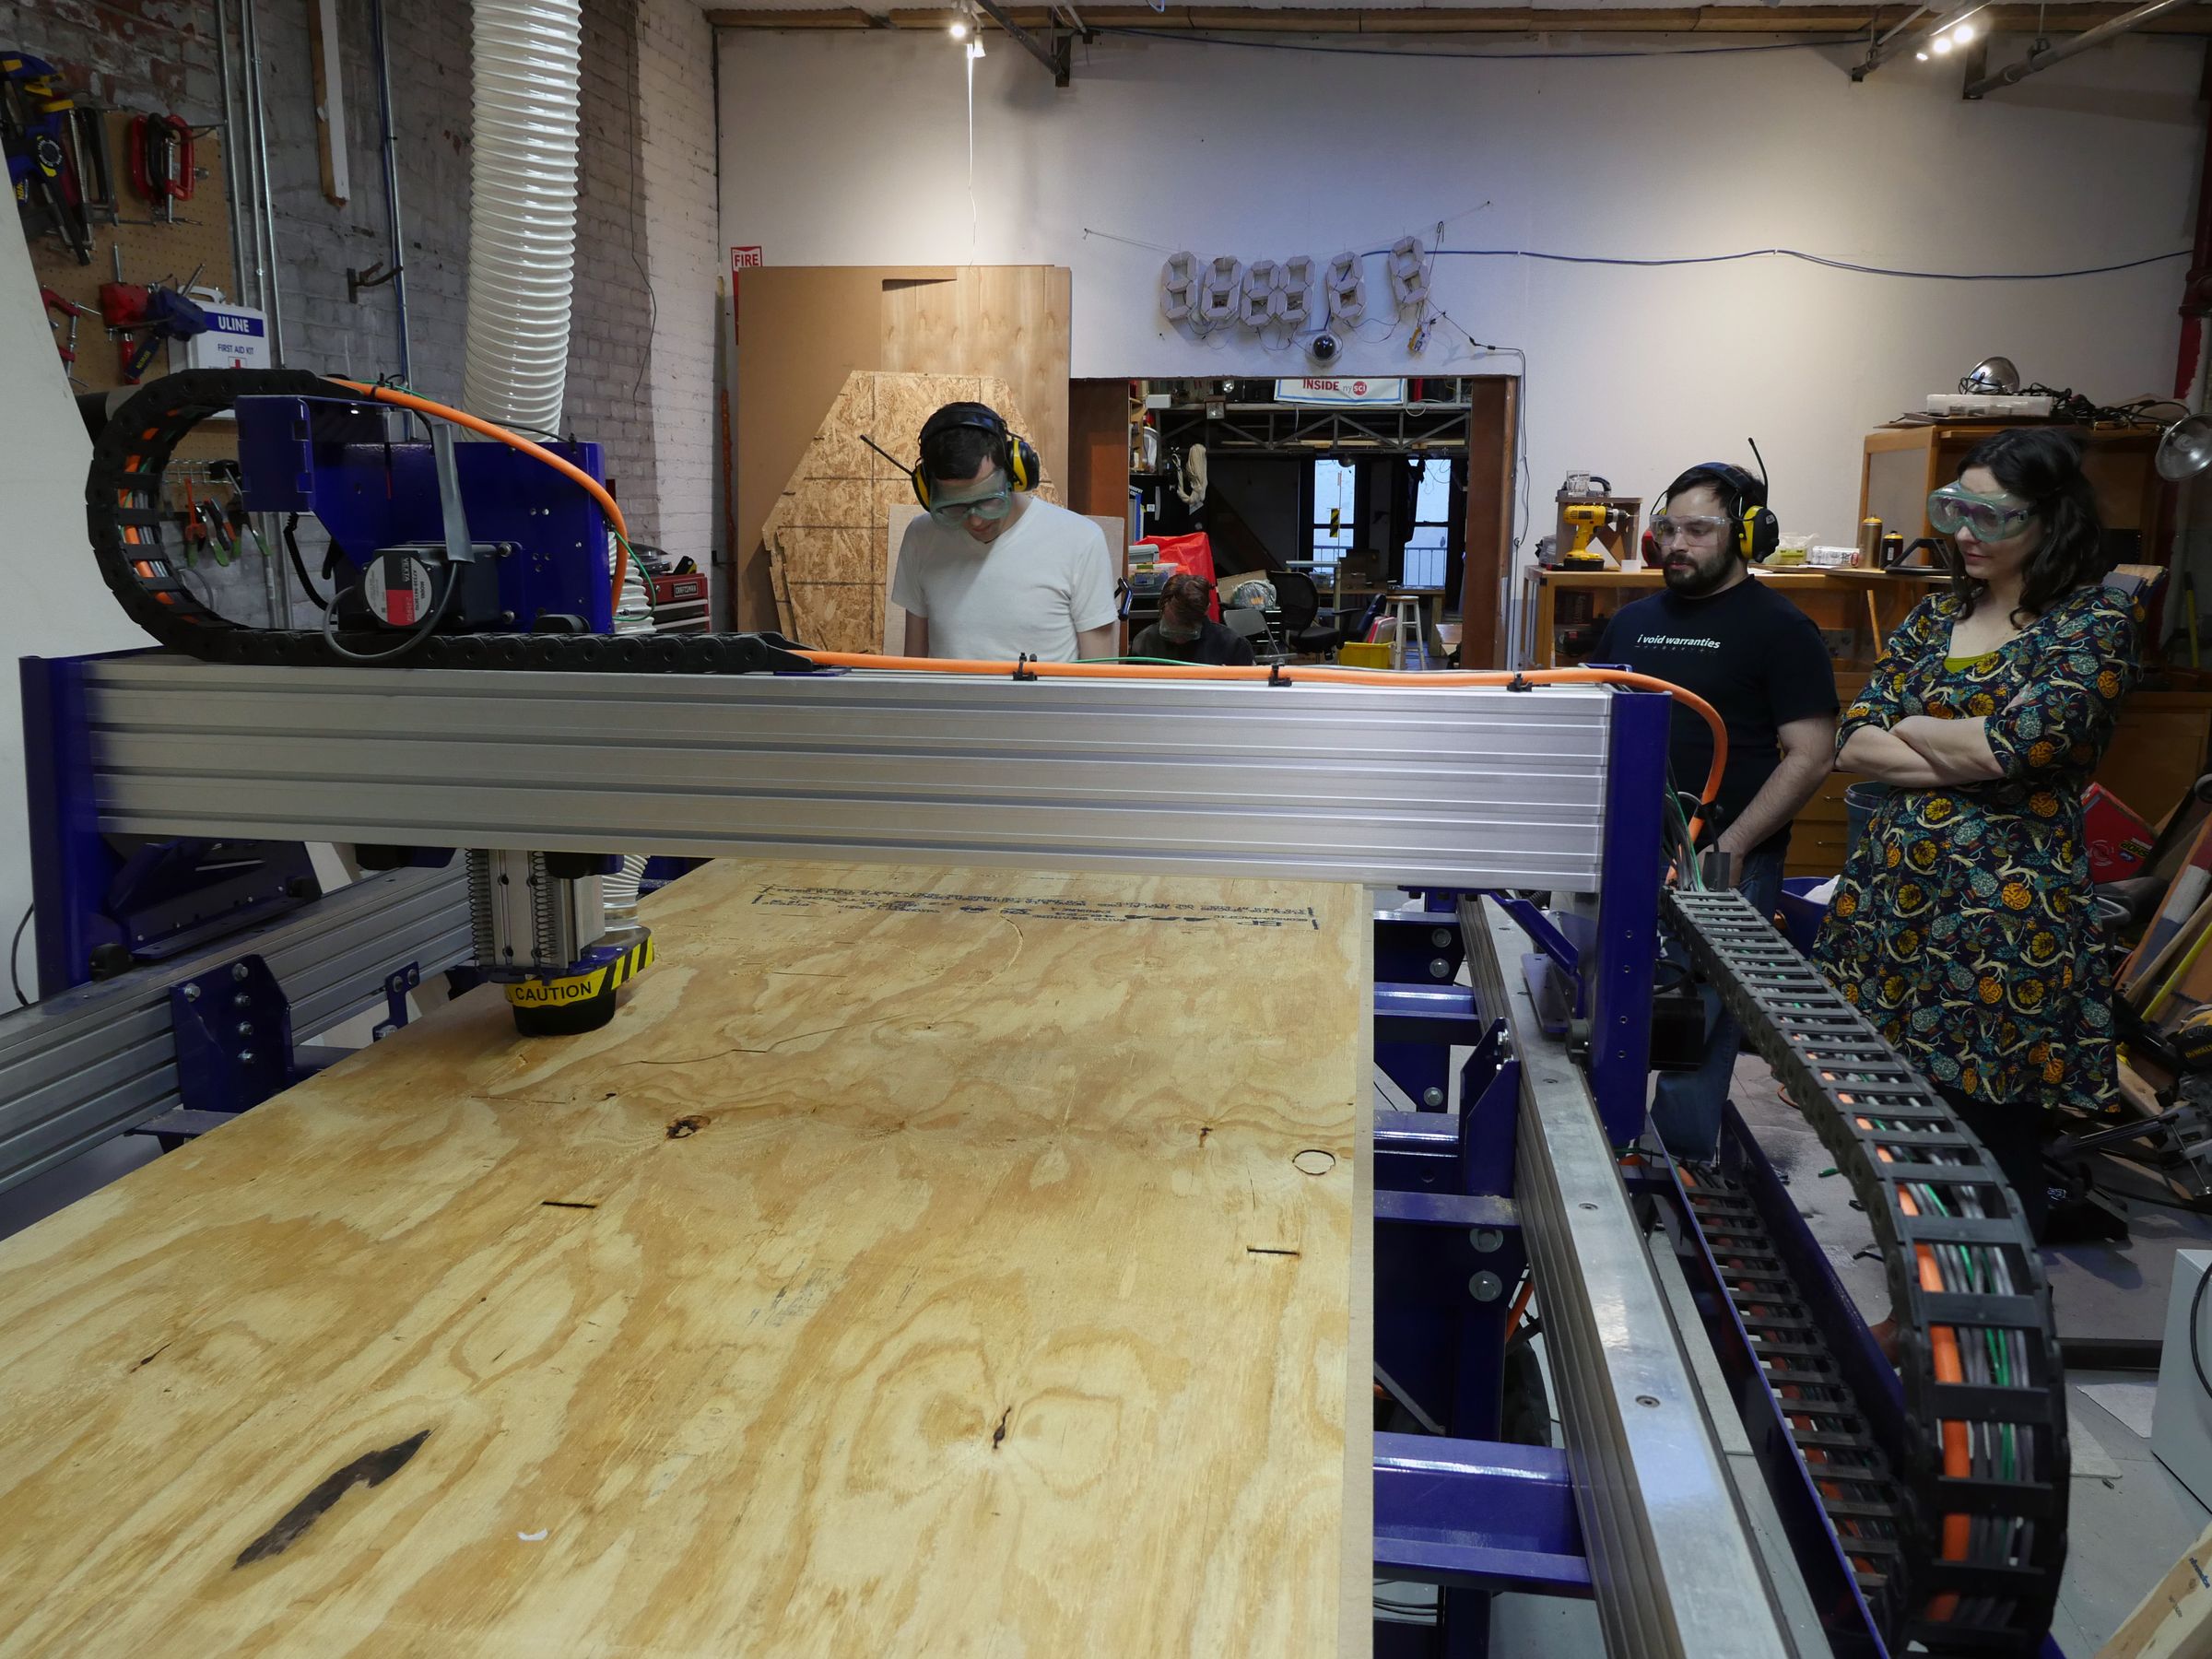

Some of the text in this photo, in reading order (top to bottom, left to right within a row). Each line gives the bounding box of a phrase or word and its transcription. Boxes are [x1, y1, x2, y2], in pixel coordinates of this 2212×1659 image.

[735, 253, 759, 267] FIRE
[218, 315, 250, 333] ULINE
[218, 343, 254, 355] FIRST AID KIT
[1302, 379, 1339, 391] INSIDE
[1637, 633, 1721, 649] i void warranties
[515, 981, 592, 1002] CAUTION
